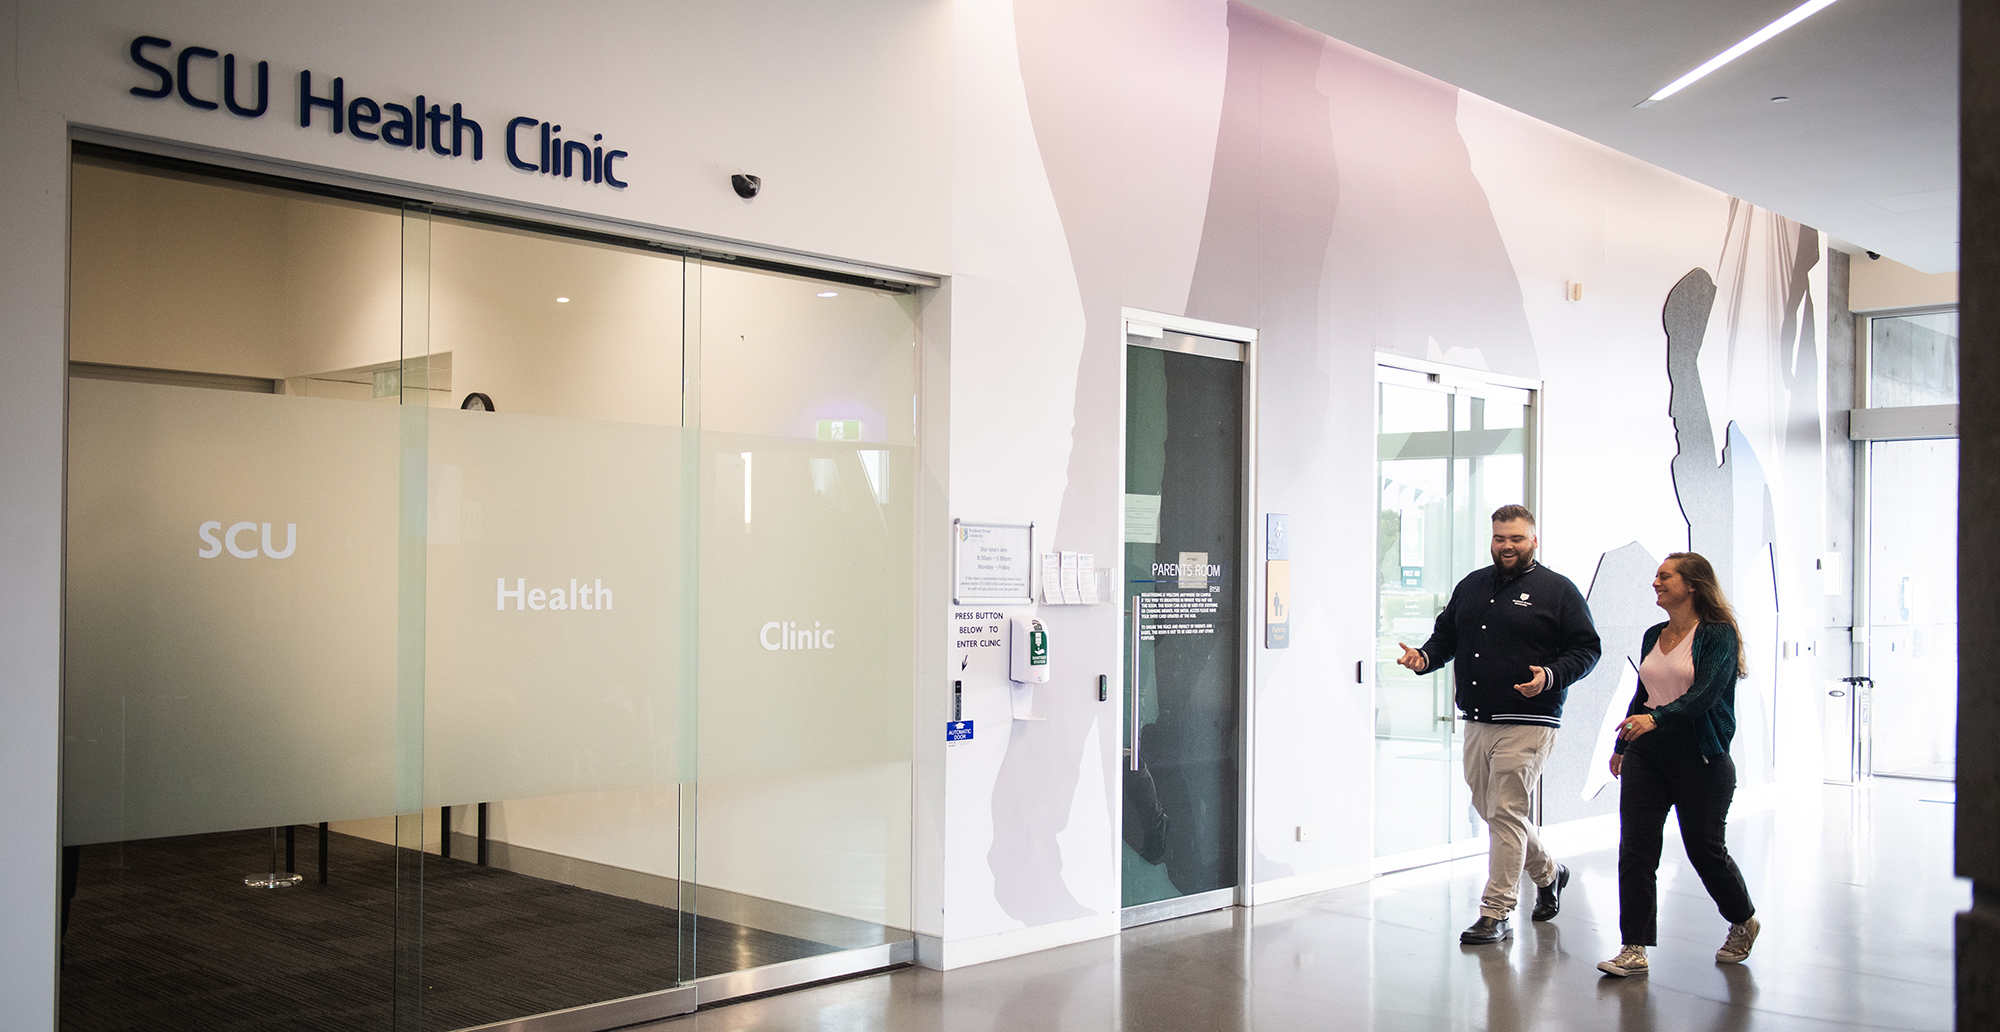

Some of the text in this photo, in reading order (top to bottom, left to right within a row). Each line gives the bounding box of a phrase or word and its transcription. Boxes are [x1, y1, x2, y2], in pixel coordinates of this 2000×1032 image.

[129, 36, 629, 188] SCU Health Clinic
[198, 520, 297, 560] SCU
[1152, 563, 1220, 577] PARENTS ROOM
[497, 577, 613, 611] Health
[760, 620, 836, 651] Clinic
[957, 640, 978, 648] ENTER
